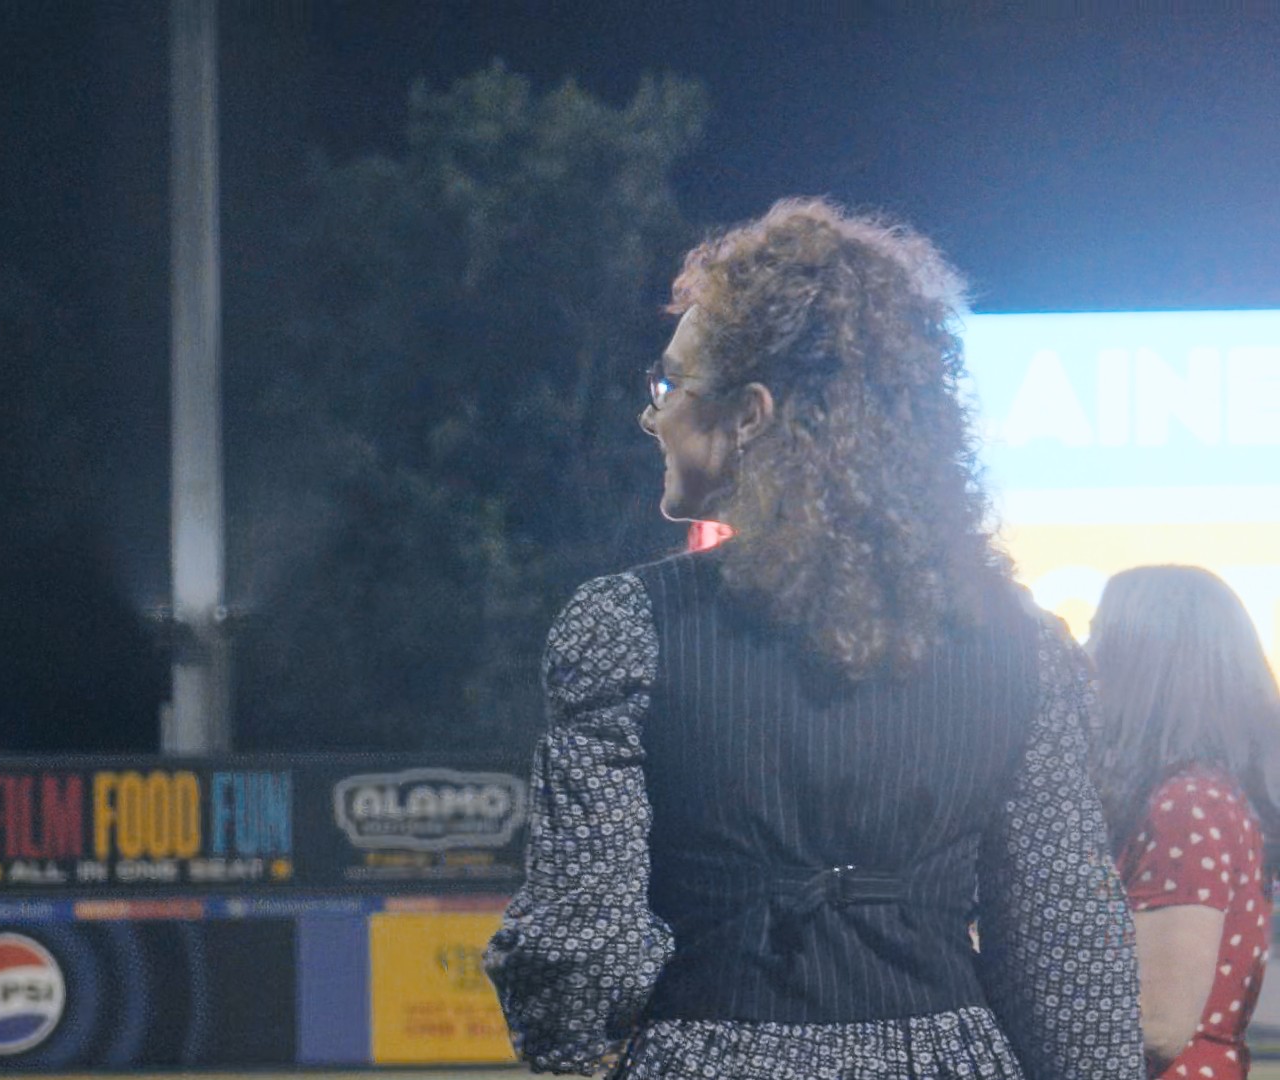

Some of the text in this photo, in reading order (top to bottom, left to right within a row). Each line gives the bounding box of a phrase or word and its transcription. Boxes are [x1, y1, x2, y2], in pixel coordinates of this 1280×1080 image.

[93, 769, 201, 861] FOOD
[211, 771, 292, 853] FUN
[352, 784, 512, 819] ALAMO
[9, 860, 67, 883] ALL
[76, 860, 108, 882] IN
[116, 859, 178, 882] ONE
